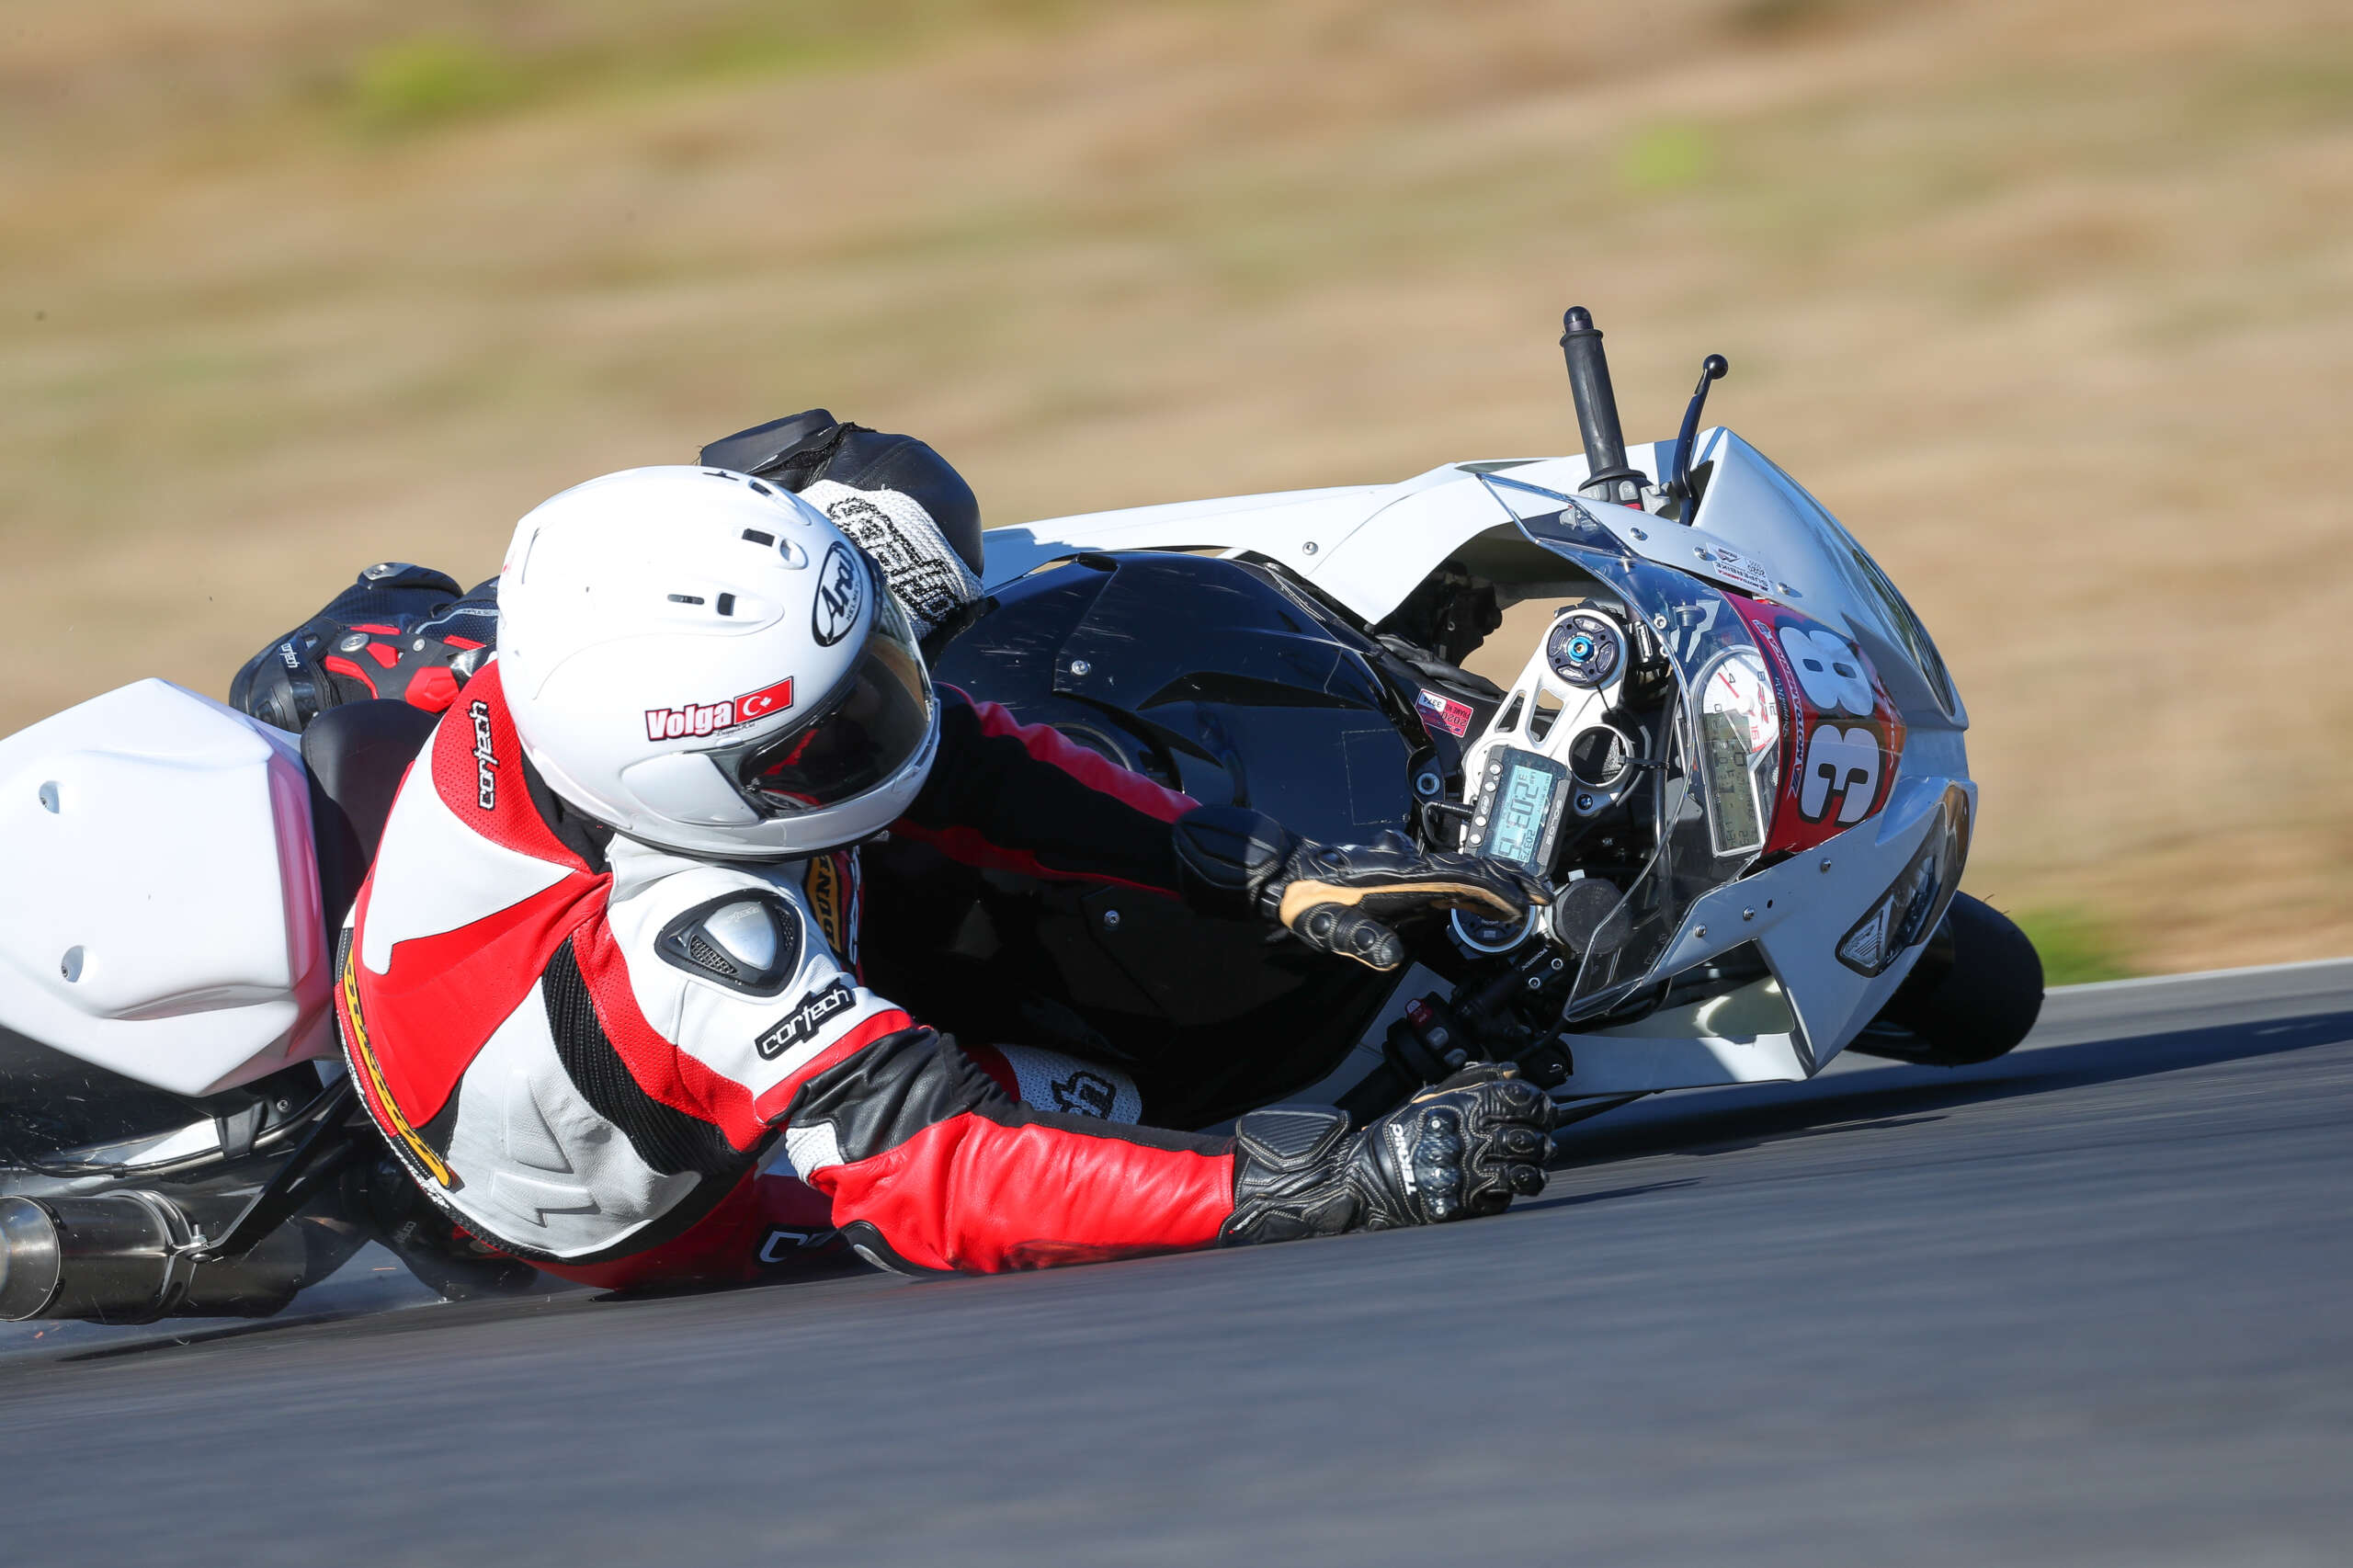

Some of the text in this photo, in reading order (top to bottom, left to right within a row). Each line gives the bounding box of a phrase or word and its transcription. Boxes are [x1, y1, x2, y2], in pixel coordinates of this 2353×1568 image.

[821, 545, 855, 643] Arai
[469, 700, 498, 810] cortech
[646, 700, 734, 742] Volga
[1779, 626, 1881, 824] 38
[762, 988, 849, 1055] cortech
[1389, 1122, 1417, 1196] TEKNIC
